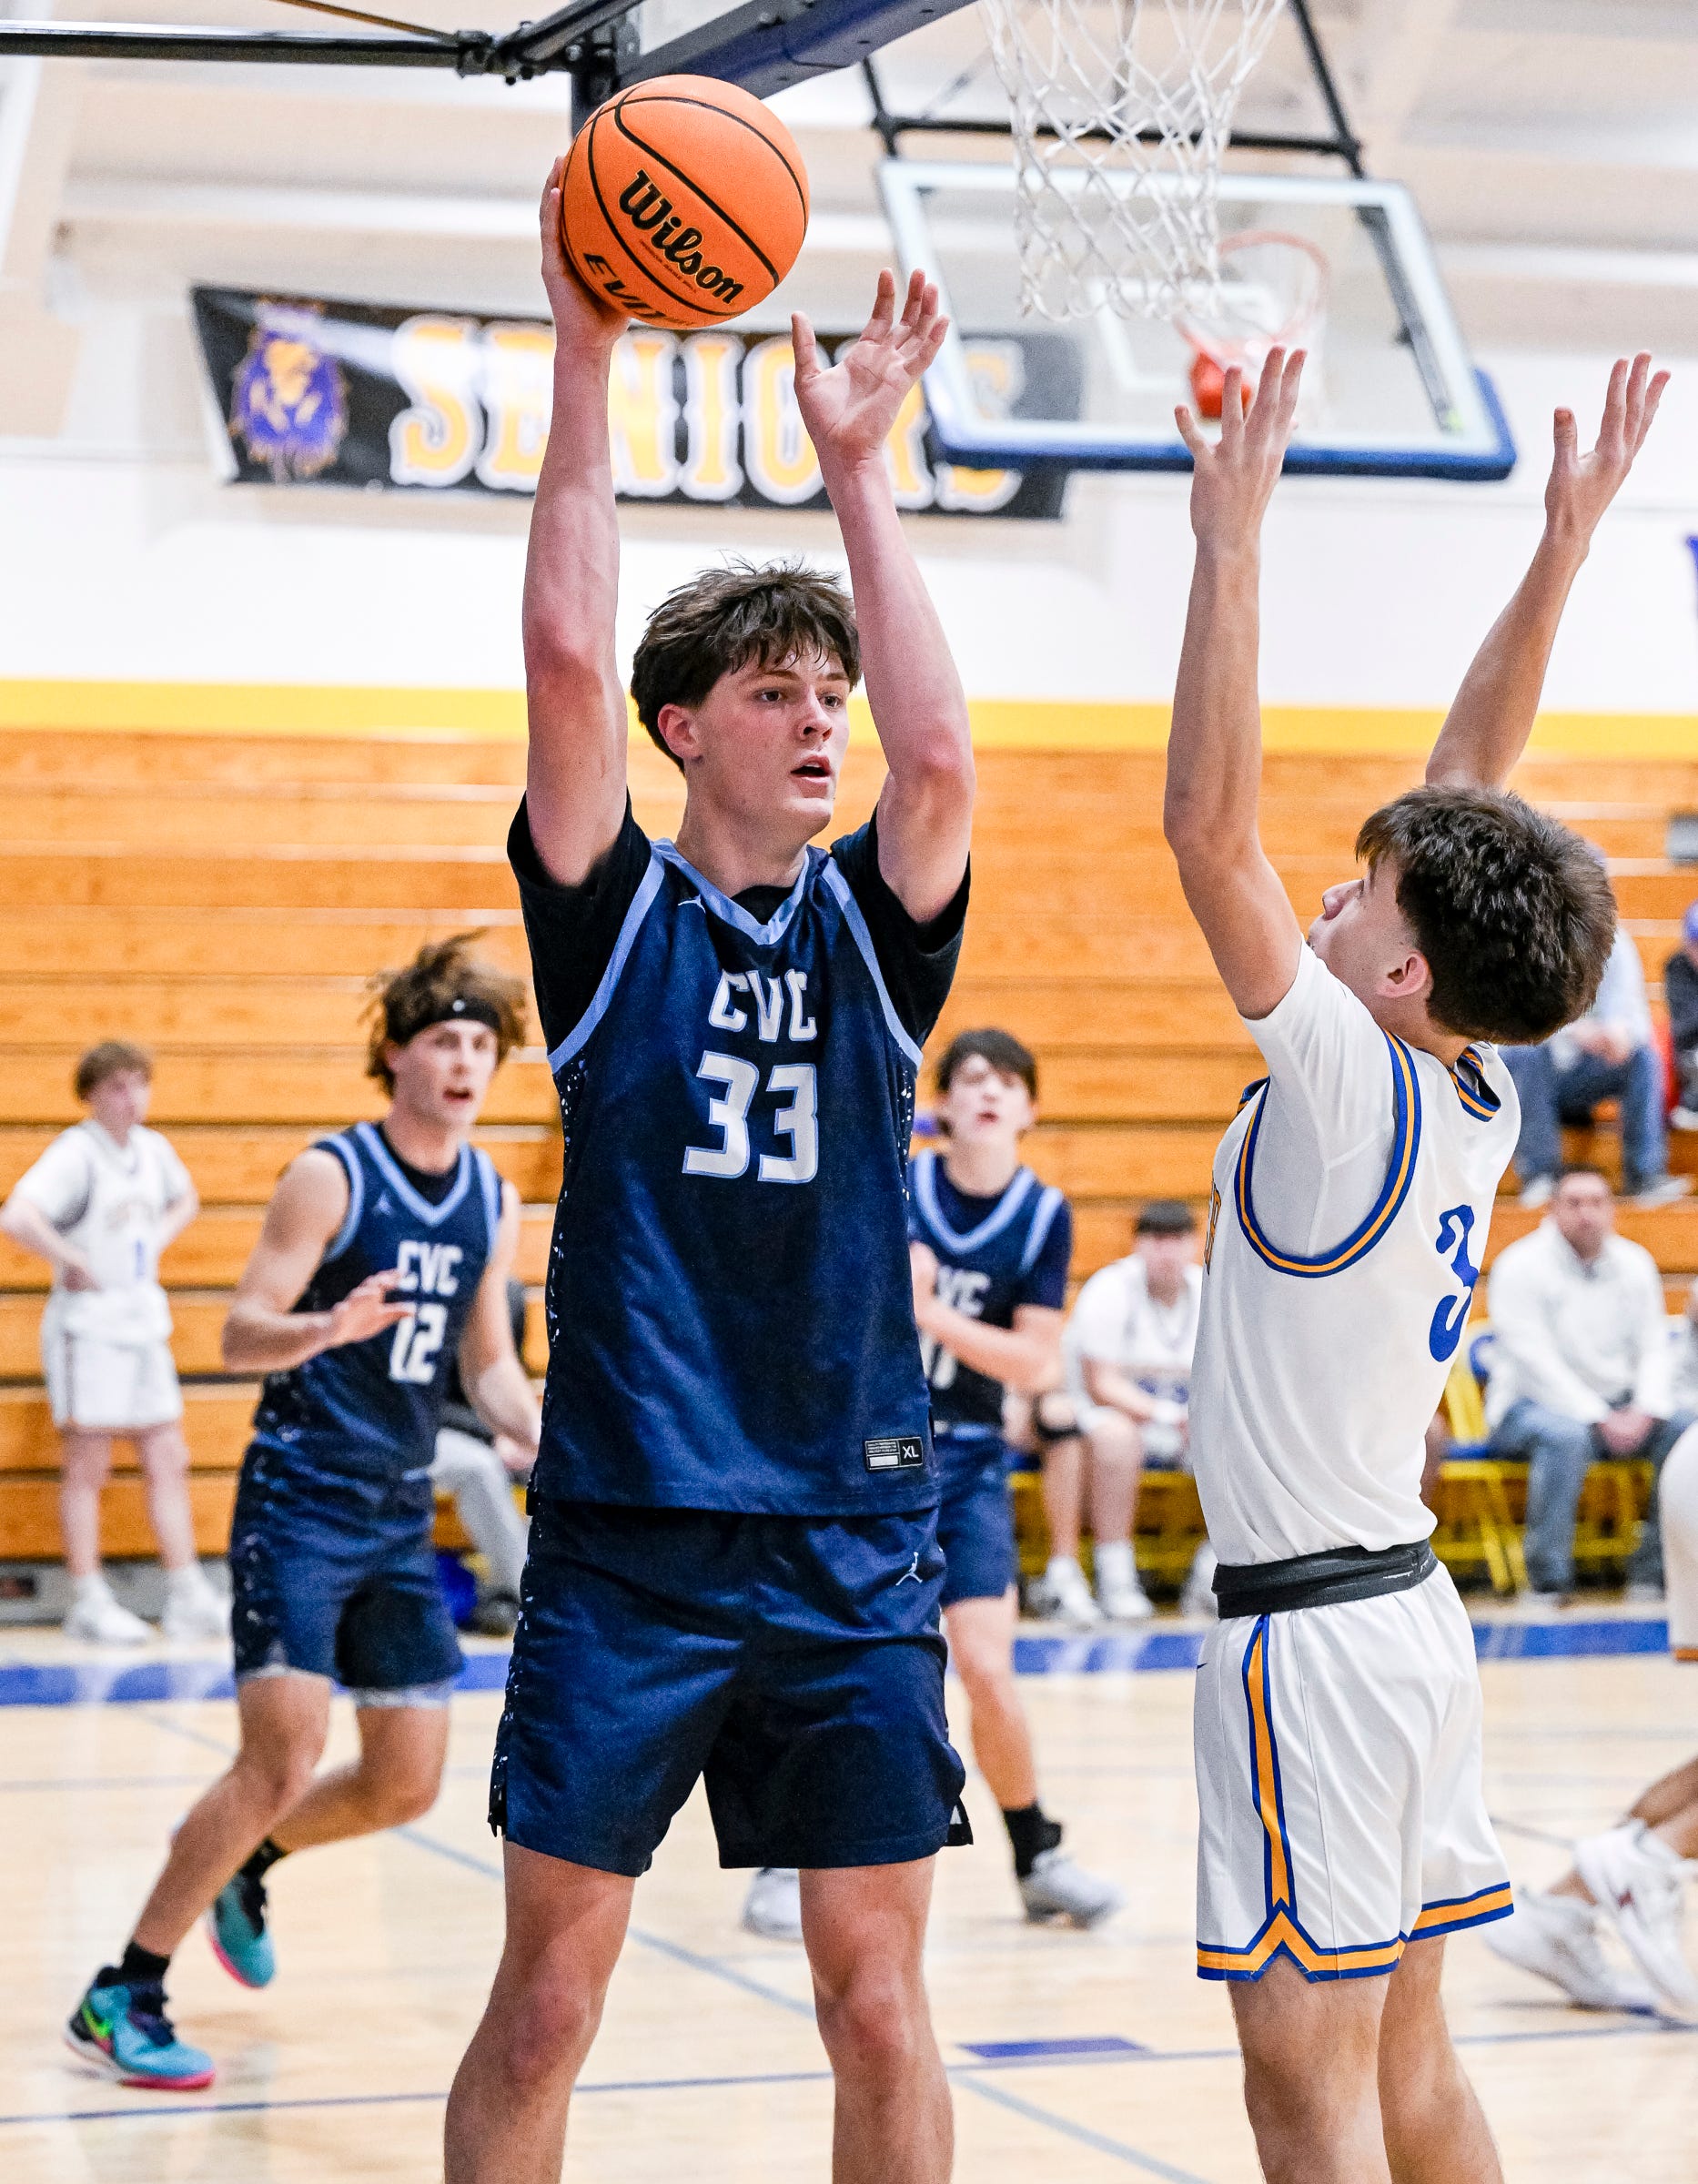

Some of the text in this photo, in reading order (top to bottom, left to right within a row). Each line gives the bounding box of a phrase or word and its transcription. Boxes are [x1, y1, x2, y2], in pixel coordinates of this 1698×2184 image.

[619, 169, 744, 305] Wilson
[708, 969, 817, 1043] CVC
[682, 1050, 819, 1184] 33
[395, 1239, 464, 1296] CVC
[1429, 1204, 1480, 1362] 3
[388, 1302, 449, 1385] 12
[902, 1445, 920, 1460] XL
